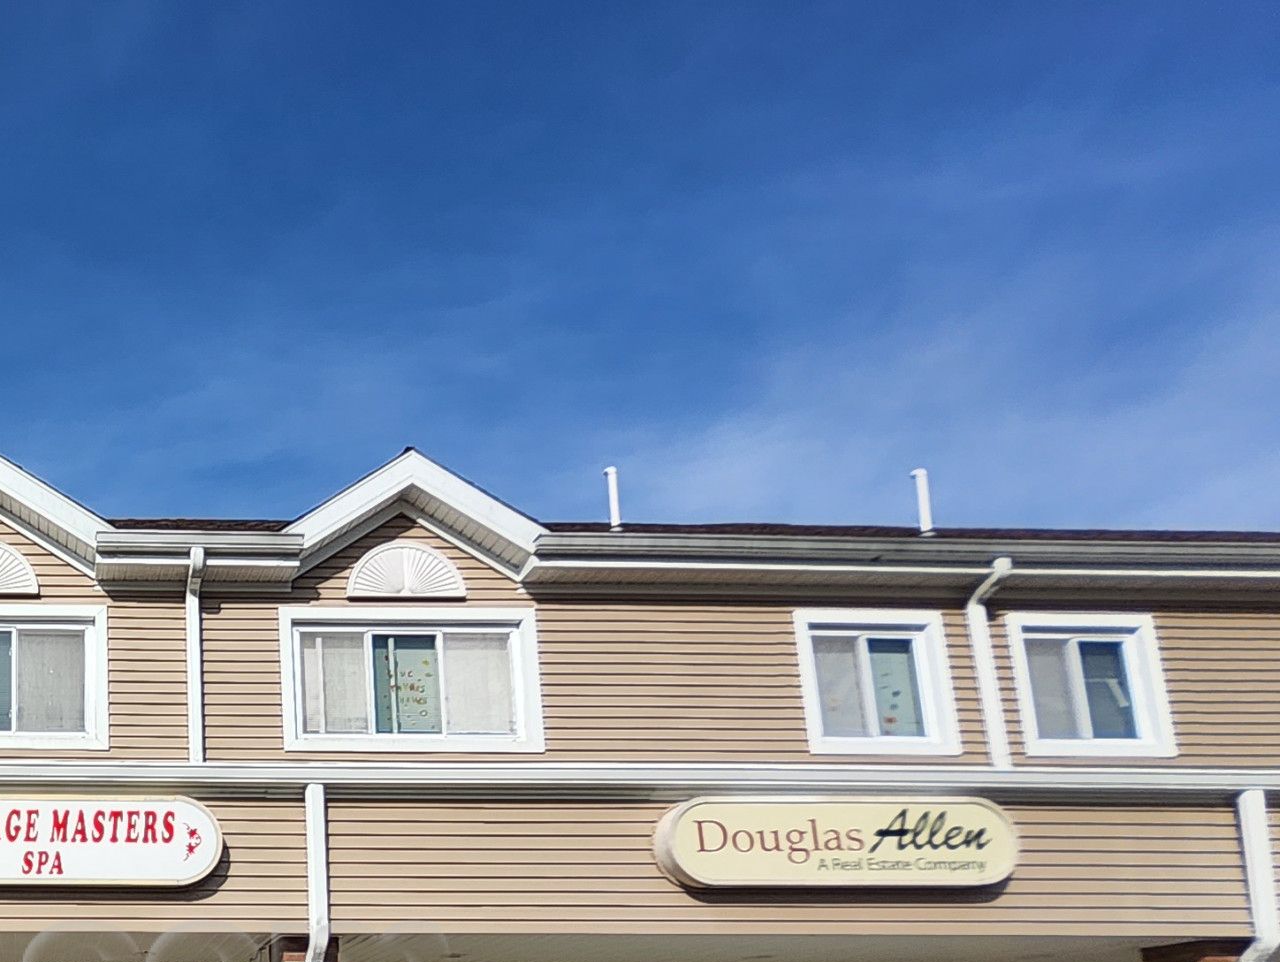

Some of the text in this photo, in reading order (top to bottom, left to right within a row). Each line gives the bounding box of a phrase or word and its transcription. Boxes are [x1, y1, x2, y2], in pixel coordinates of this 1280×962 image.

[49, 809, 176, 844] MASTERS
[693, 808, 993, 865] Douglas Allen
[21, 850, 64, 875] SPA
[817, 858, 988, 873] A Real Estate Company
